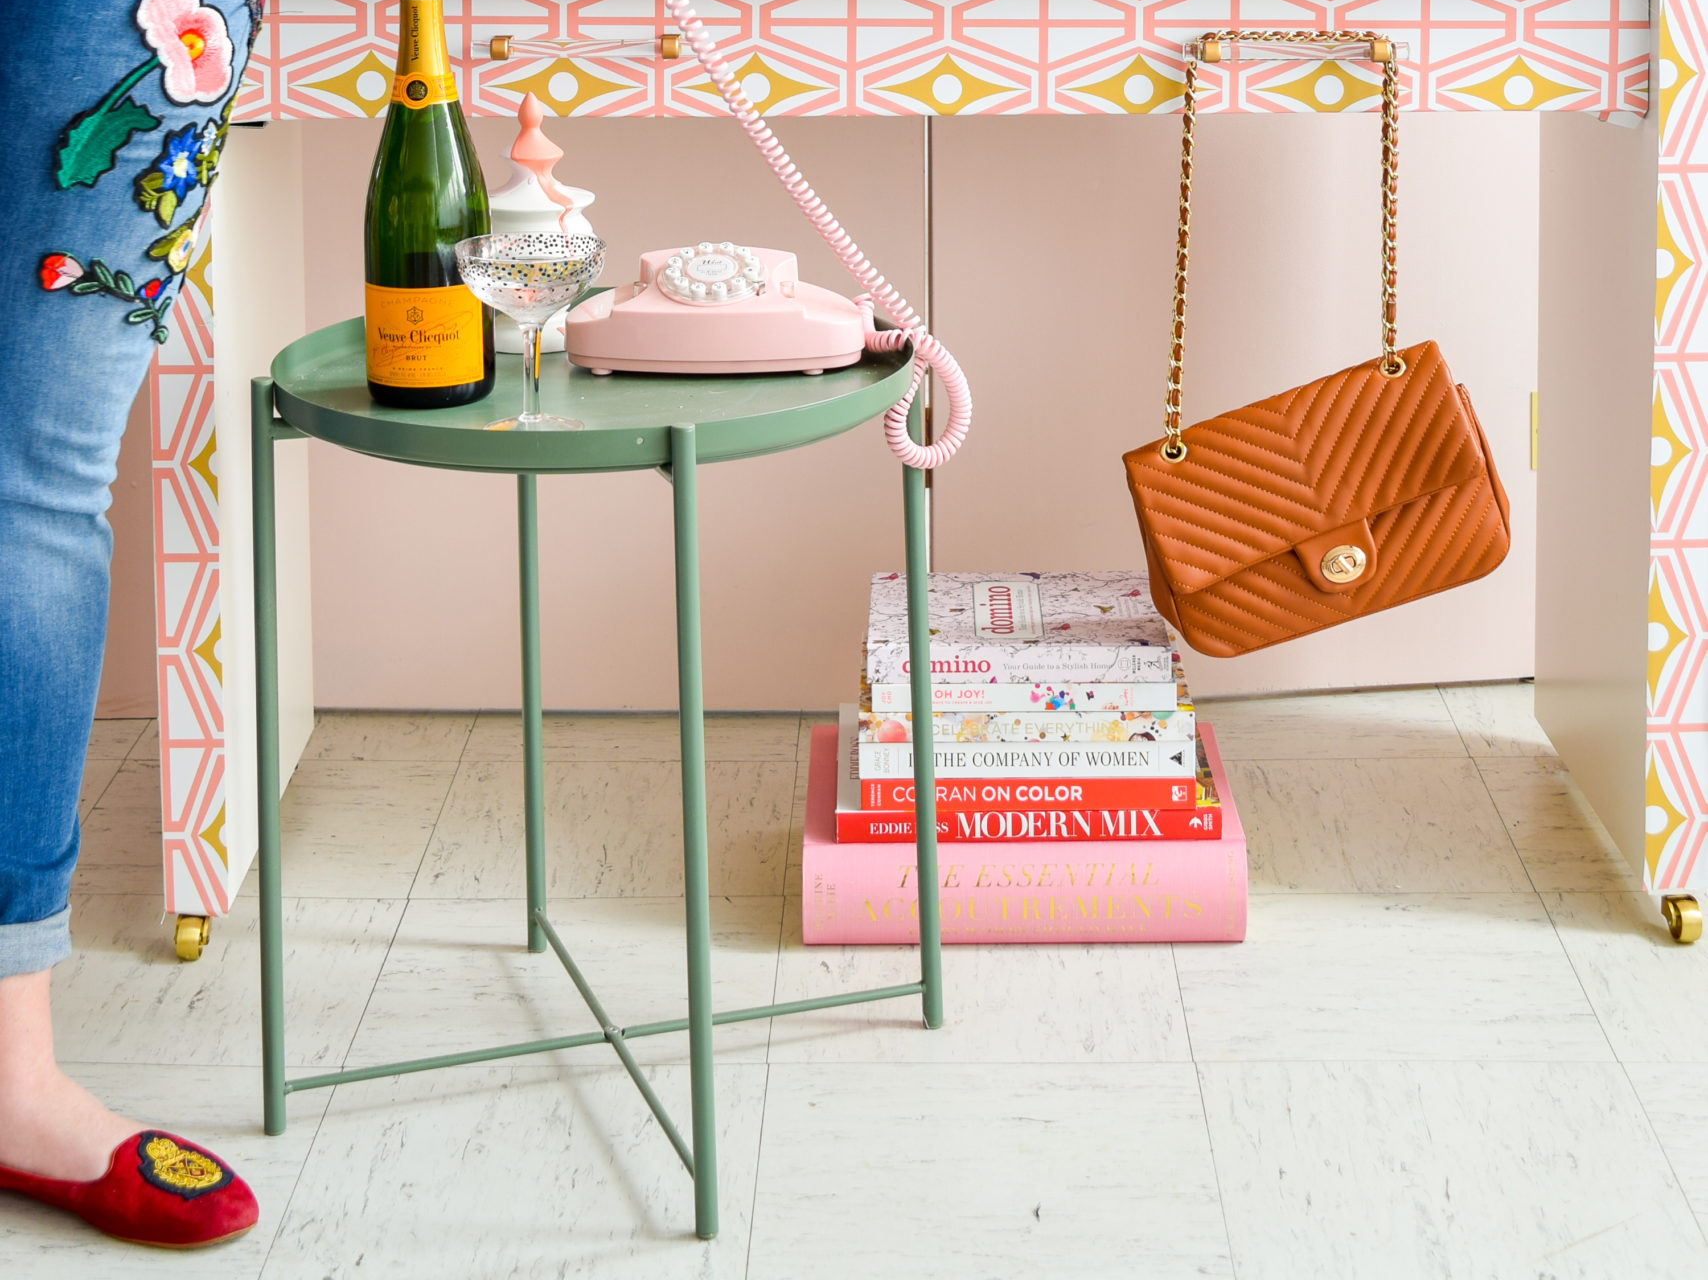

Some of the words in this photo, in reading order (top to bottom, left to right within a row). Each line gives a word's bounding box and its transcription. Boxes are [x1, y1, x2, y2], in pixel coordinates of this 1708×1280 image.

[411, 6, 420, 37] Clicquot
[411, 39, 419, 61] Veuve
[378, 327, 407, 342] Veuve
[409, 329, 459, 345] Clicquot
[979, 585, 1015, 635] domino
[902, 655, 991, 674] mino
[1003, 663, 1020, 671] Your
[1062, 663, 1088, 672] Stylish
[934, 689, 952, 699] OH
[957, 689, 985, 699] JOY!
[934, 752, 966, 767] THE
[972, 752, 1051, 768] COMPANY
[1058, 752, 1080, 767] OF
[1085, 751, 1150, 767] WOMEN
[892, 786, 976, 802] CORAN
[981, 786, 1010, 801] ON
[1015, 785, 1083, 801] COLOR
[869, 822, 912, 834] EDDIE
[955, 811, 1092, 839] MODERN
[1099, 810, 1164, 836] MIX
[898, 864, 965, 888] TE
[975, 862, 1160, 888] ESSENTIAL
